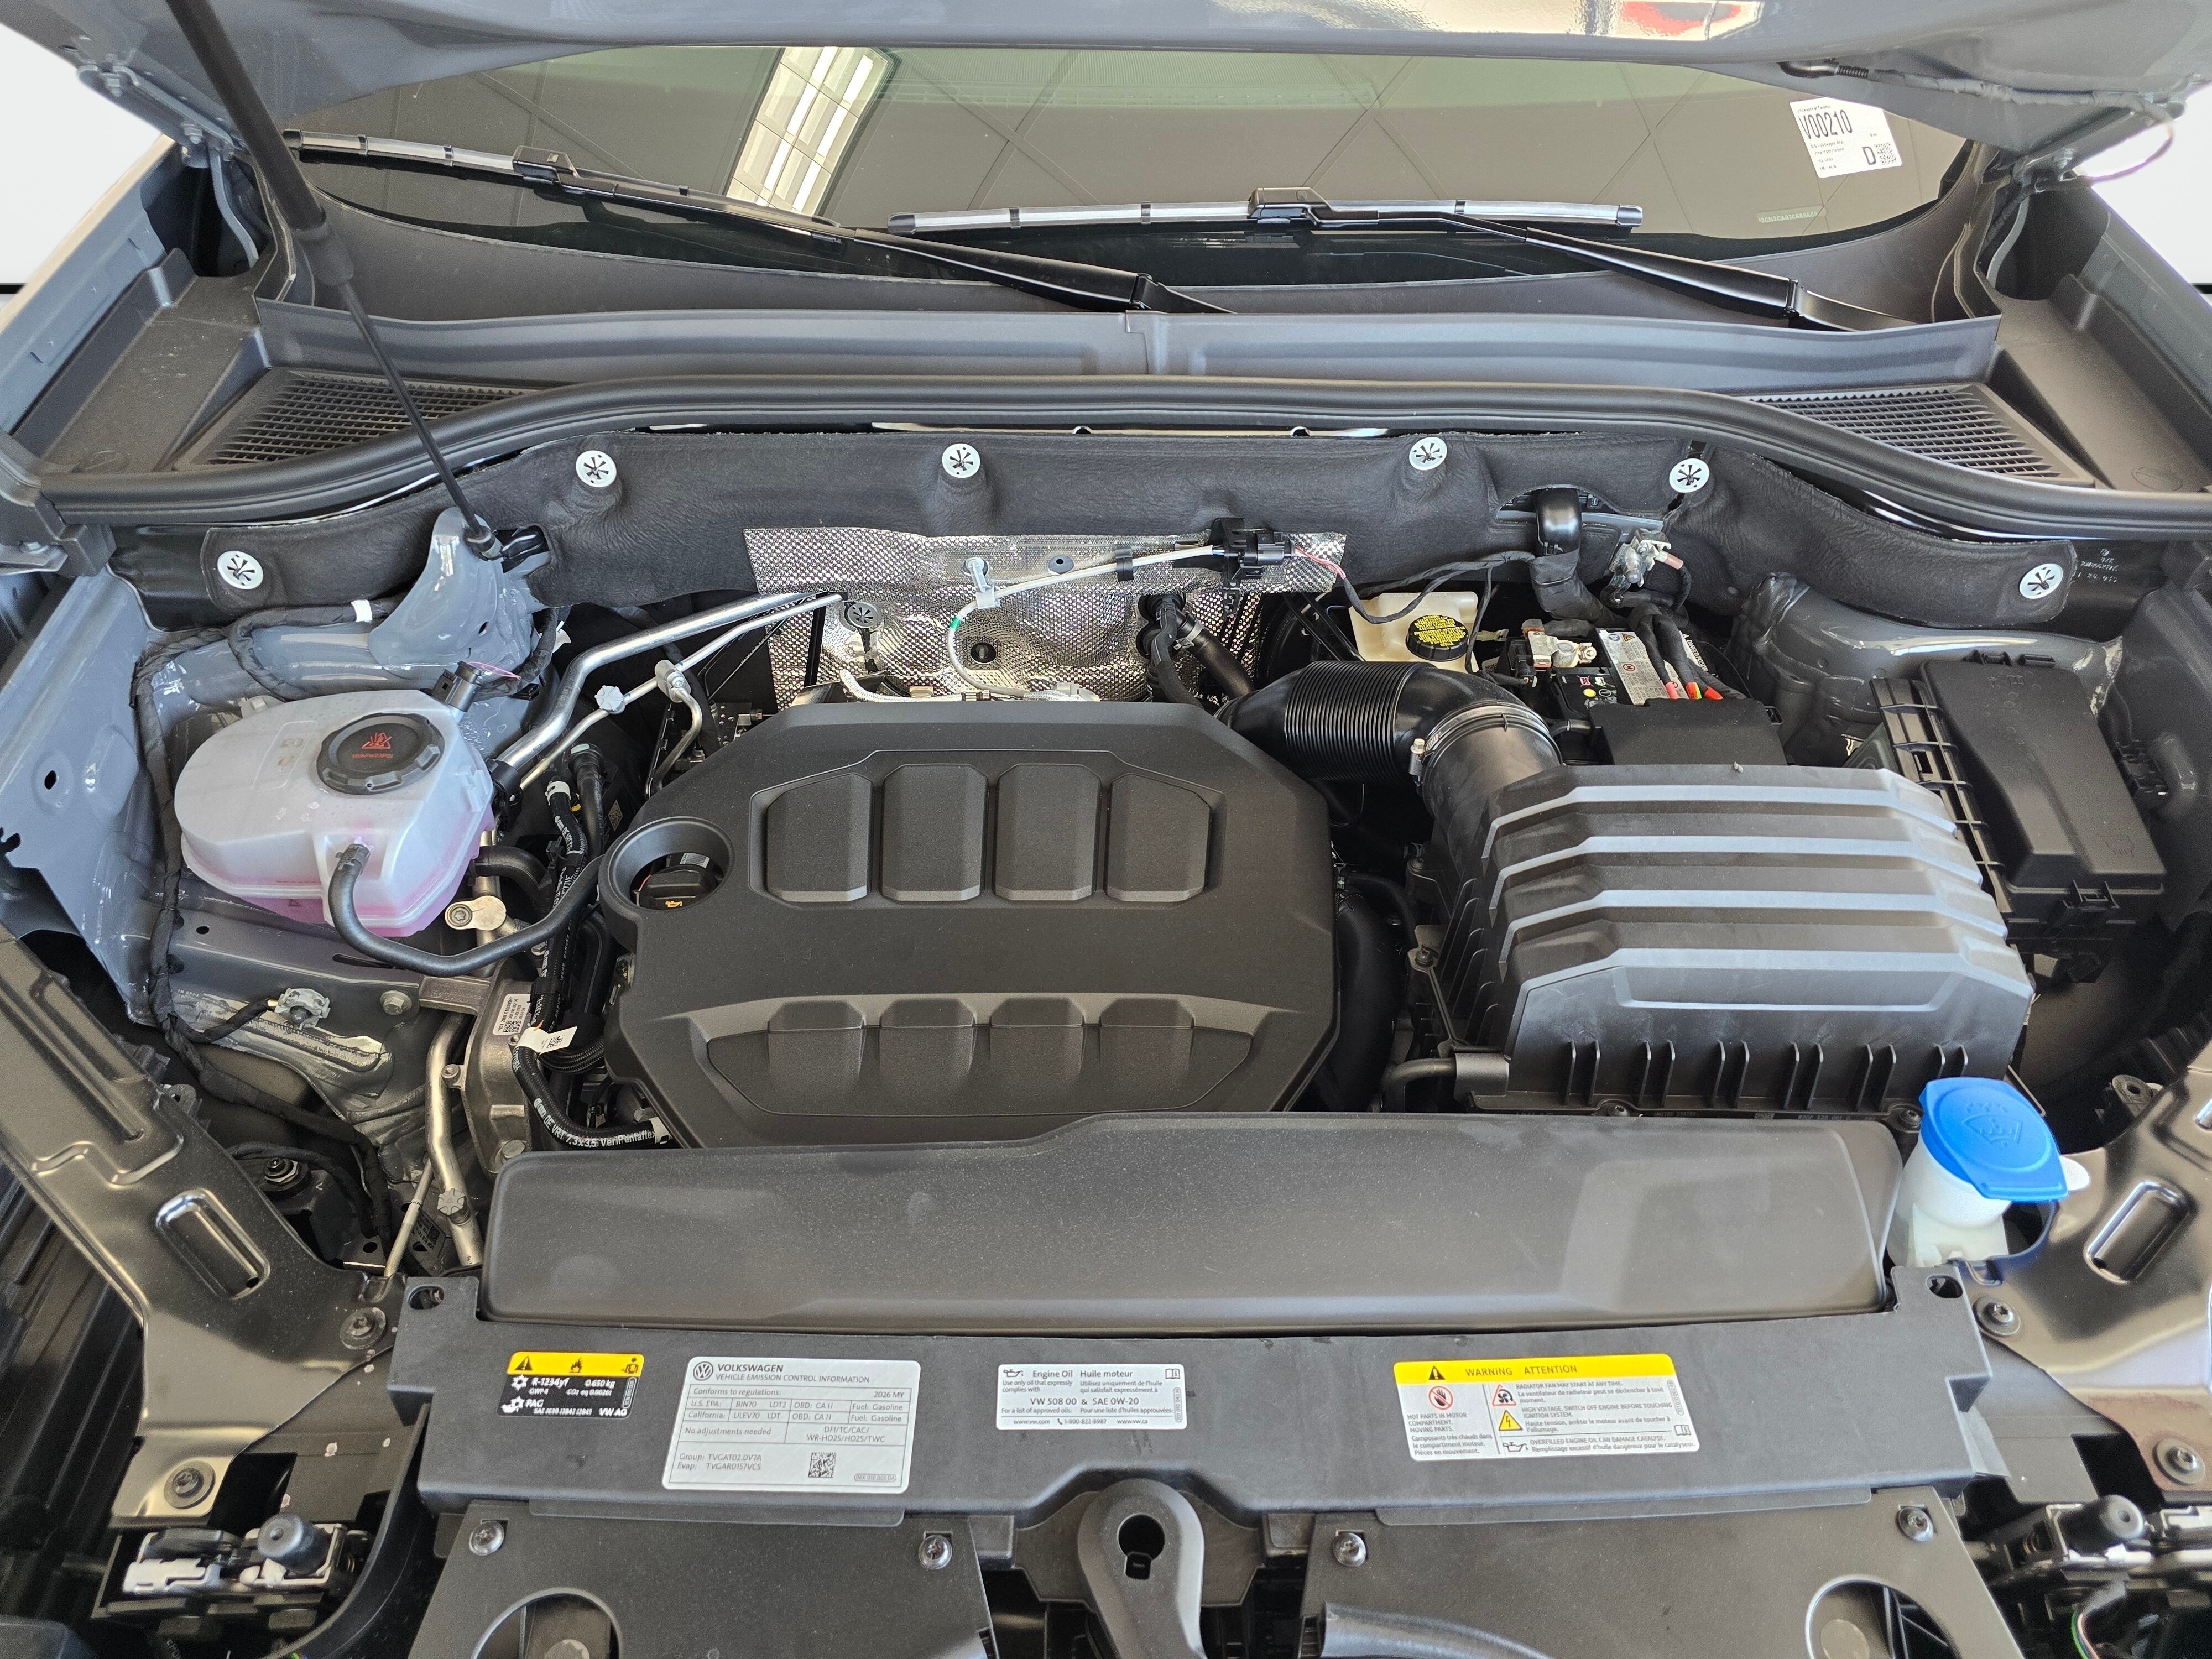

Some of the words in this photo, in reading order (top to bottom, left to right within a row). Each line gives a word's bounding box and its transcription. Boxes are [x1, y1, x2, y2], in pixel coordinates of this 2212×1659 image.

[1798, 109, 1852, 139] V00210
[1862, 146, 1876, 165] D
[551, 1124, 567, 1139] VRT
[718, 1364, 784, 1372] VOLKSWAGEN
[1465, 1367, 1512, 1377] WARNING
[1524, 1364, 1578, 1375] ATTENTION
[1033, 1370, 1060, 1379] Engine
[531, 1378, 570, 1389] R-1234yf
[585, 1379, 606, 1387] 0.650
[606, 1380, 615, 1389] kg
[525, 1399, 544, 1407] PAG
[614, 1408, 627, 1417] AG
[697, 1427, 743, 1436] adjustments
[807, 1434, 885, 1442] WR-HO2S/HO2S/TWC
[679, 1453, 705, 1462] Group:
[677, 1462, 697, 1471] Evap:
